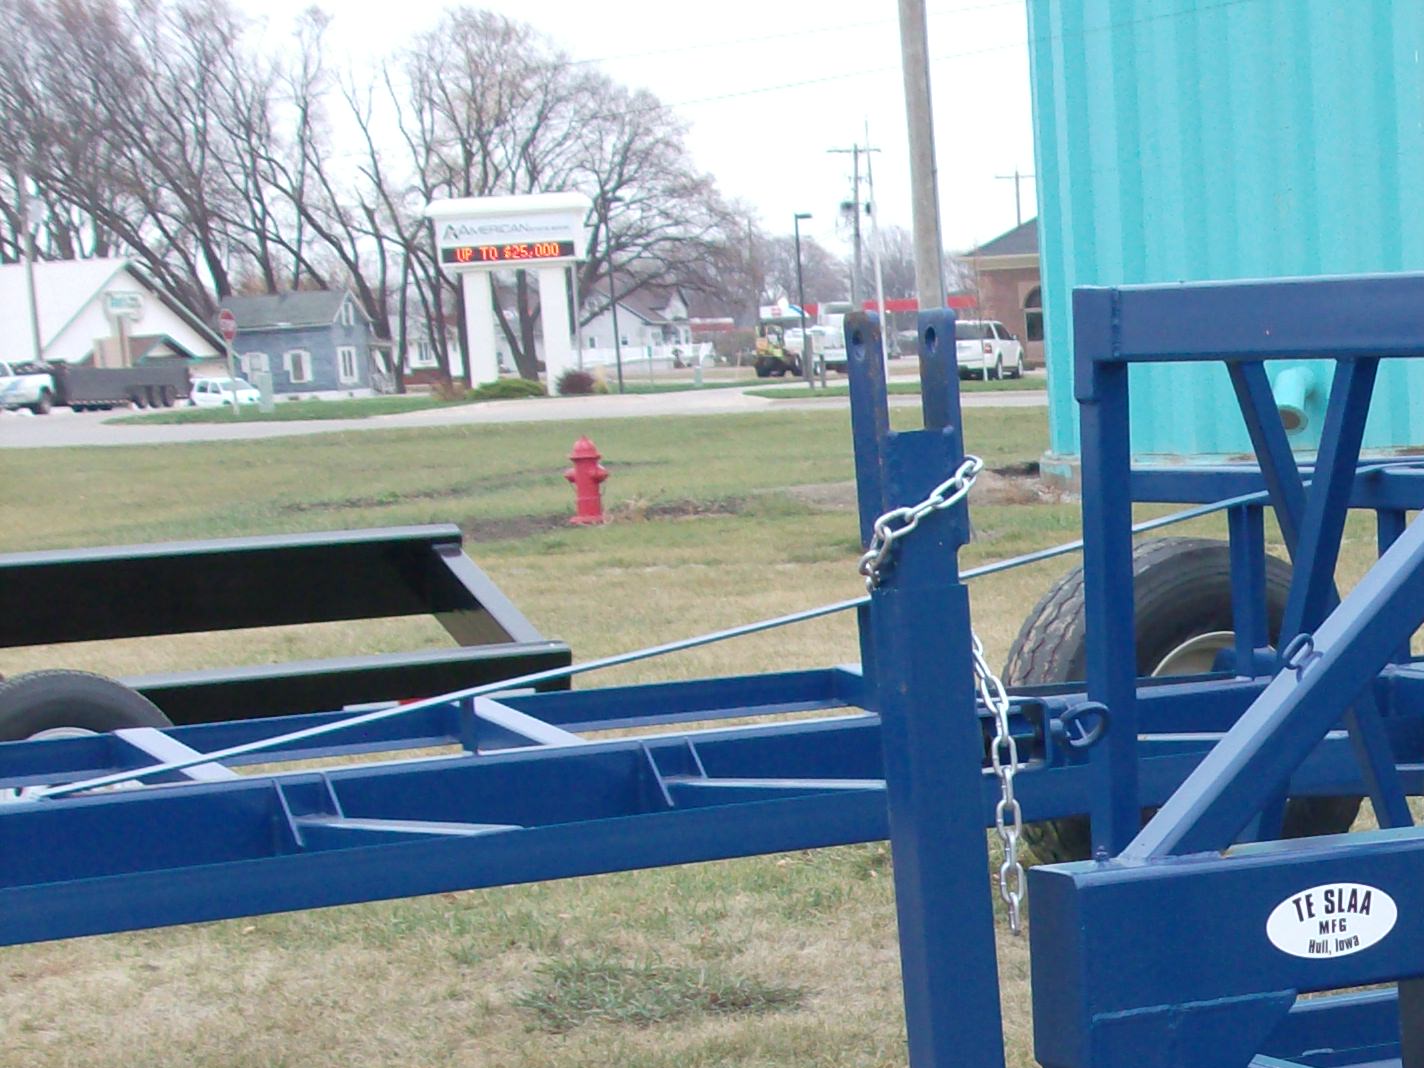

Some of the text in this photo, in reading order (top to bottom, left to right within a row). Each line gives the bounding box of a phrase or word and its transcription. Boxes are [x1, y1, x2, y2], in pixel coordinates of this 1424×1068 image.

[455, 246, 474, 263] UP
[479, 245, 499, 261] TO
[1292, 888, 1372, 922] TE SLAA
[1319, 918, 1347, 935] MFG
[1308, 934, 1360, 956] Hull, Iowa
